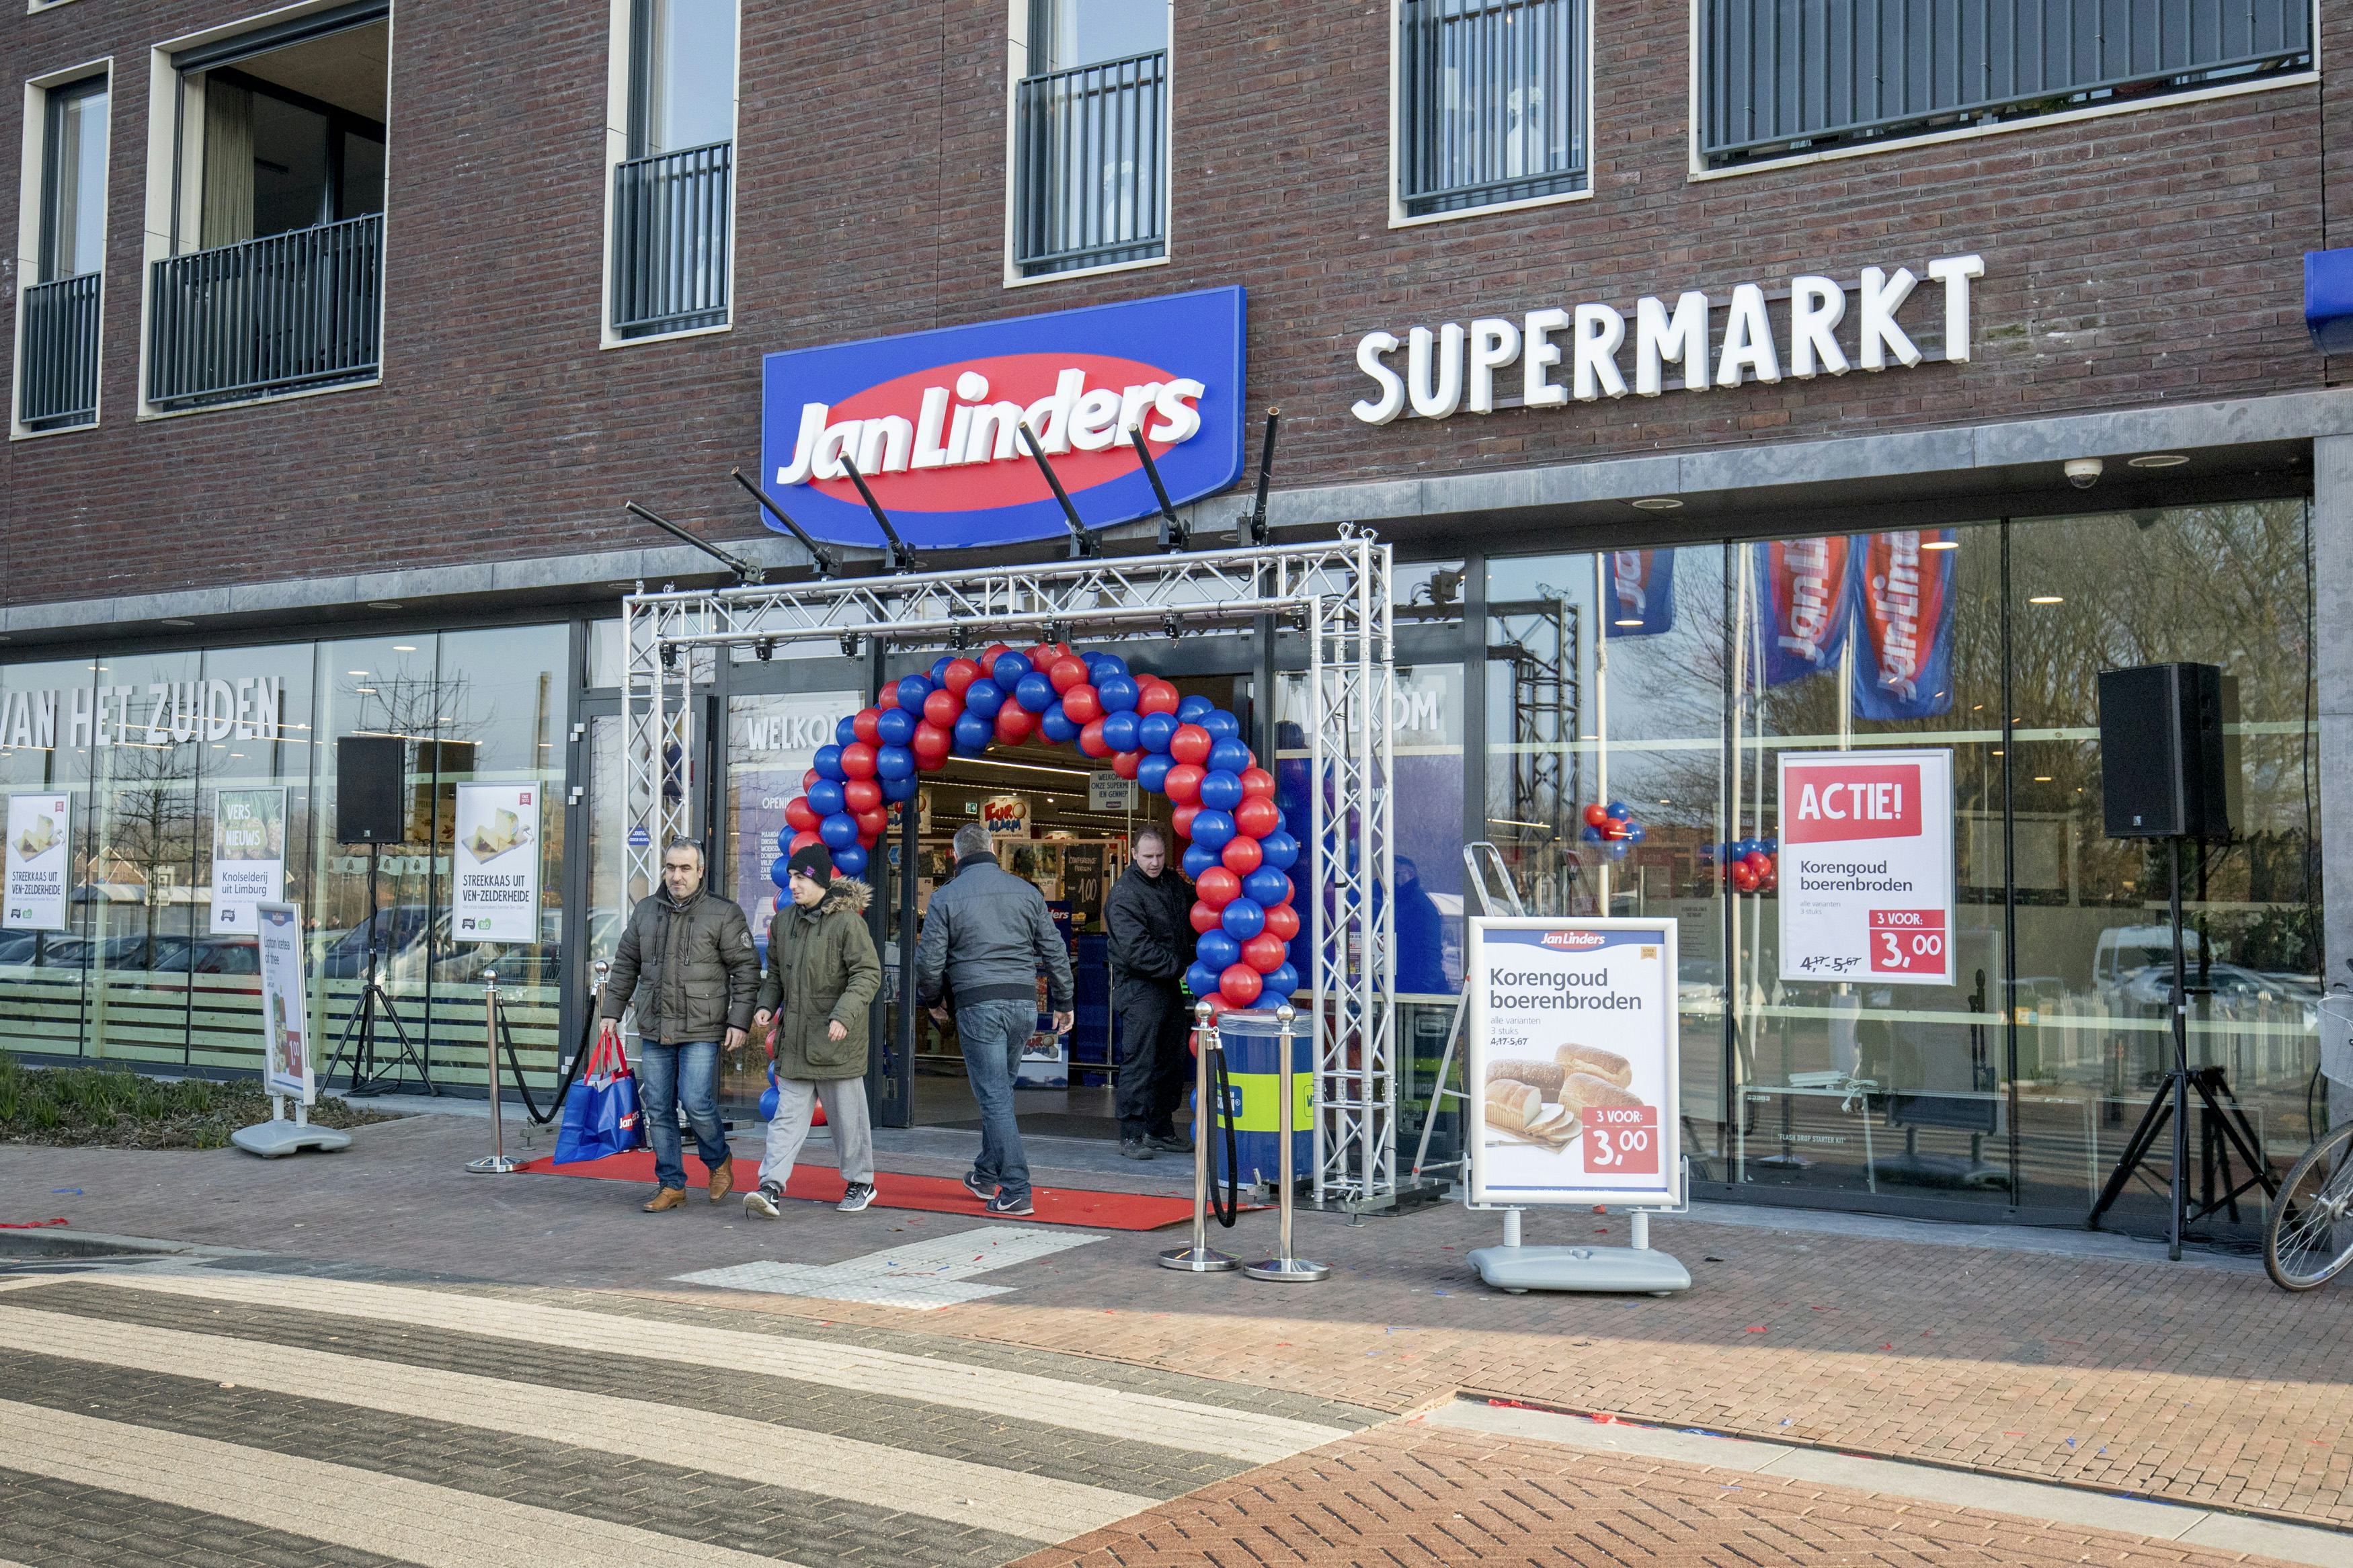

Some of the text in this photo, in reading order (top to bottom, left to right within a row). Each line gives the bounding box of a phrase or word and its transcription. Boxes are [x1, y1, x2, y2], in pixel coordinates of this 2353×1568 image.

[1351, 255, 1984, 425] SUPERMARKT
[70, 685, 133, 747] HET
[146, 676, 280, 744] ZUIDEN
[1300, 690, 1437, 733] WLOM
[1798, 783, 1902, 820] ACTIE!
[227, 804, 250, 820] VERS
[985, 801, 1026, 821] EURO
[988, 817, 1021, 833] ALARM
[226, 830, 260, 845] NIEUWS
[1801, 860, 1887, 876] Korengoud
[12, 872, 58, 882] STREEKKAAS UIT
[223, 872, 268, 884] Knolselderij
[463, 875, 525, 886] STREEKKAAS UIT
[1801, 877, 1913, 892] boerenbroden
[12, 884, 61, 895] VEN-ZELDERHEIDE
[222, 884, 267, 897] uit Limburg
[463, 890, 529, 902] VEN-ZELDERHEIDE
[1878, 913, 1923, 925] 3 VOOR:
[264, 936, 290, 950] Lipton Icetea
[1881, 932, 1942, 968] 3,00
[265, 952, 280, 965] of thee
[1490, 968, 1607, 991] Korengoud
[1490, 991, 1642, 1010] boerenbroden
[1490, 1016, 1541, 1024] alle varianten
[1597, 1110, 1642, 1123] 3 VOOR:
[1593, 1130, 1647, 1166] 3,00
